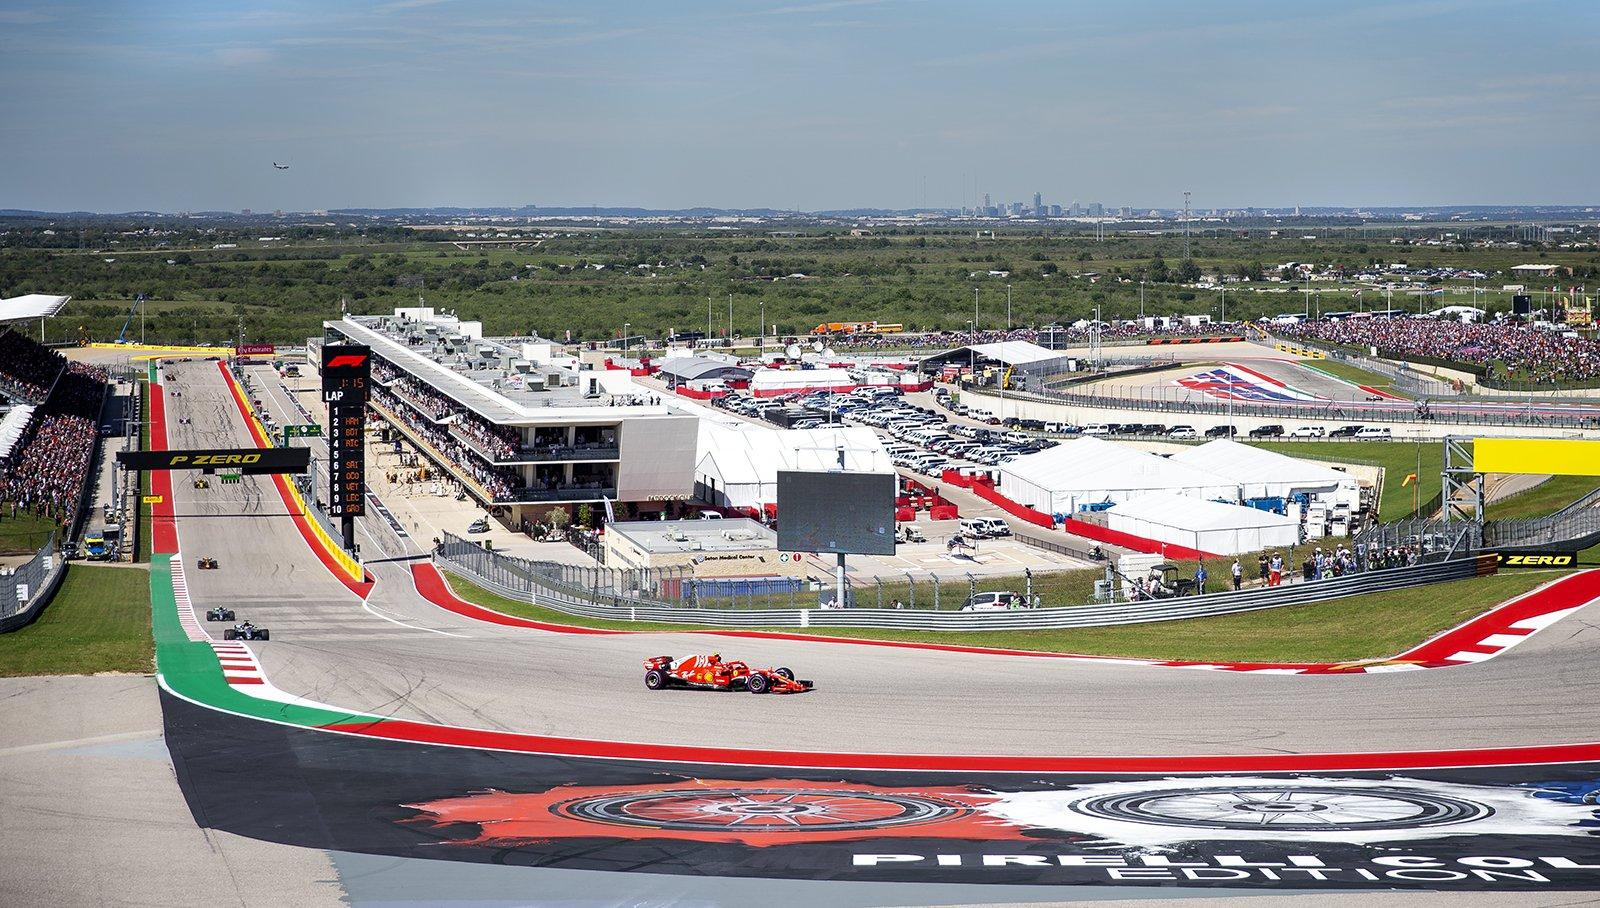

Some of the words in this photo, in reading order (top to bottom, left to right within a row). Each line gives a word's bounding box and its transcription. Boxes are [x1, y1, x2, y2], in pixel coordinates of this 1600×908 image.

[325, 391, 344, 401] LAP
[333, 407, 339, 416] 1
[333, 418, 339, 426] 2
[333, 429, 339, 437] 3
[333, 440, 339, 448] 4
[333, 451, 339, 459] 5
[170, 455, 188, 466] P
[192, 454, 261, 465] ZERO
[333, 462, 339, 470] 6
[333, 473, 339, 481] 7
[333, 484, 339, 492] 8
[333, 495, 339, 503] 9
[345, 494, 360, 502] LEC
[332, 505, 342, 513] 10
[1506, 555, 1572, 565] ZERO
[852, 854, 1327, 868] PIRELLI
[1105, 867, 1552, 883] EDITION
